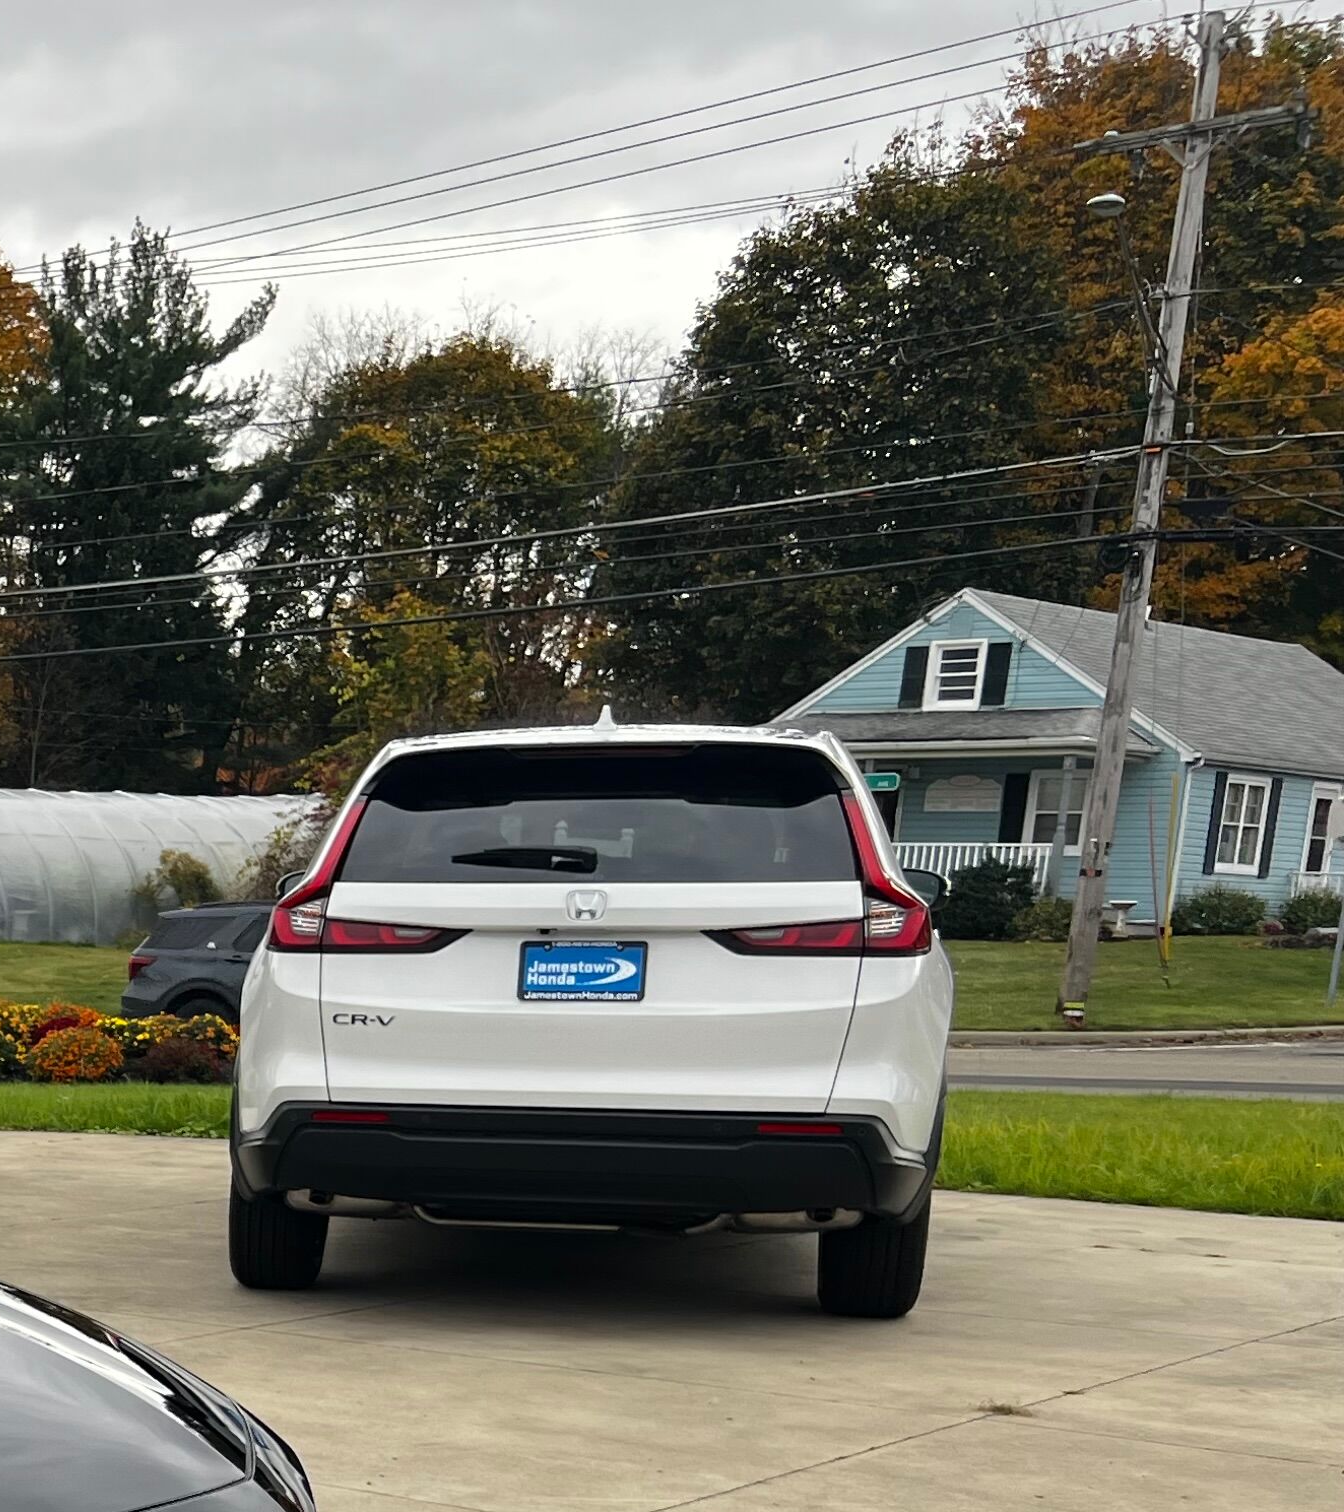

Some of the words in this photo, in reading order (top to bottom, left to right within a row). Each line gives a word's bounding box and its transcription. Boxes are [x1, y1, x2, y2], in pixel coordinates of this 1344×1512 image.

[527, 960, 615, 973] Jamestown
[526, 972, 576, 985] Honda
[524, 991, 638, 1000] JamestownHonda.com
[332, 1013, 396, 1026] CR-V
